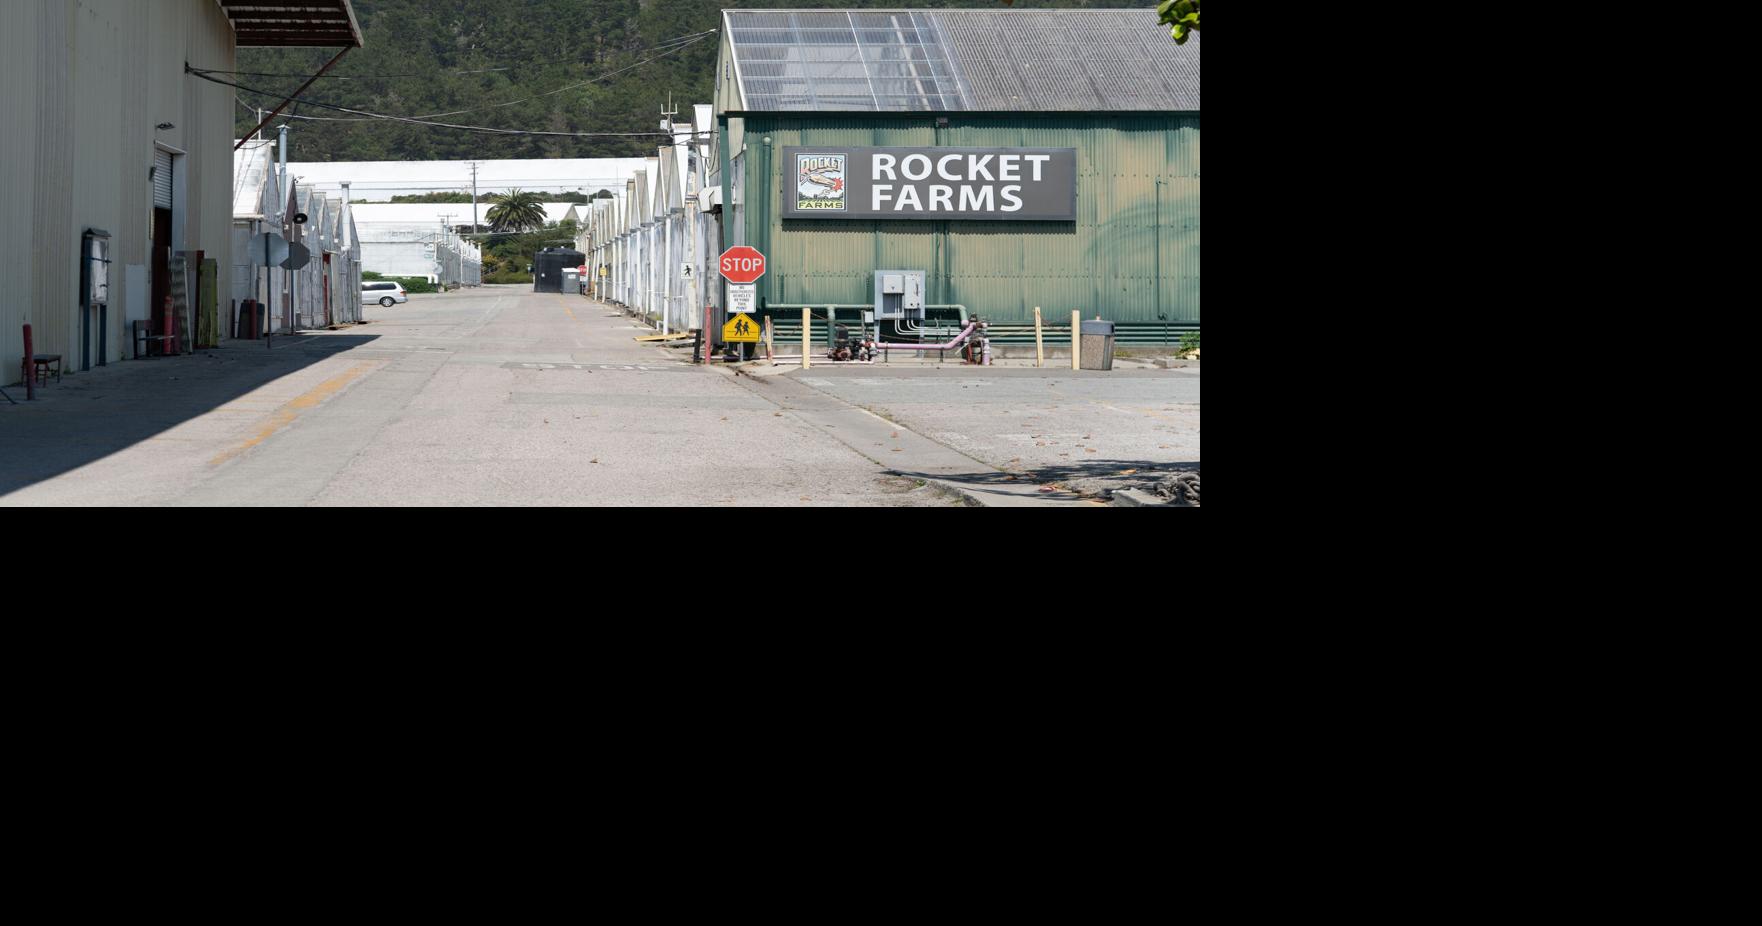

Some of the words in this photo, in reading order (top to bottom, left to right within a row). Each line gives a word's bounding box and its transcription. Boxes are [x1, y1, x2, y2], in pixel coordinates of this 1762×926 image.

[799, 157, 844, 172] ROCKET
[872, 153, 1050, 181] ROCKET
[872, 184, 1023, 212] FARMS
[722, 257, 762, 272] STOP
